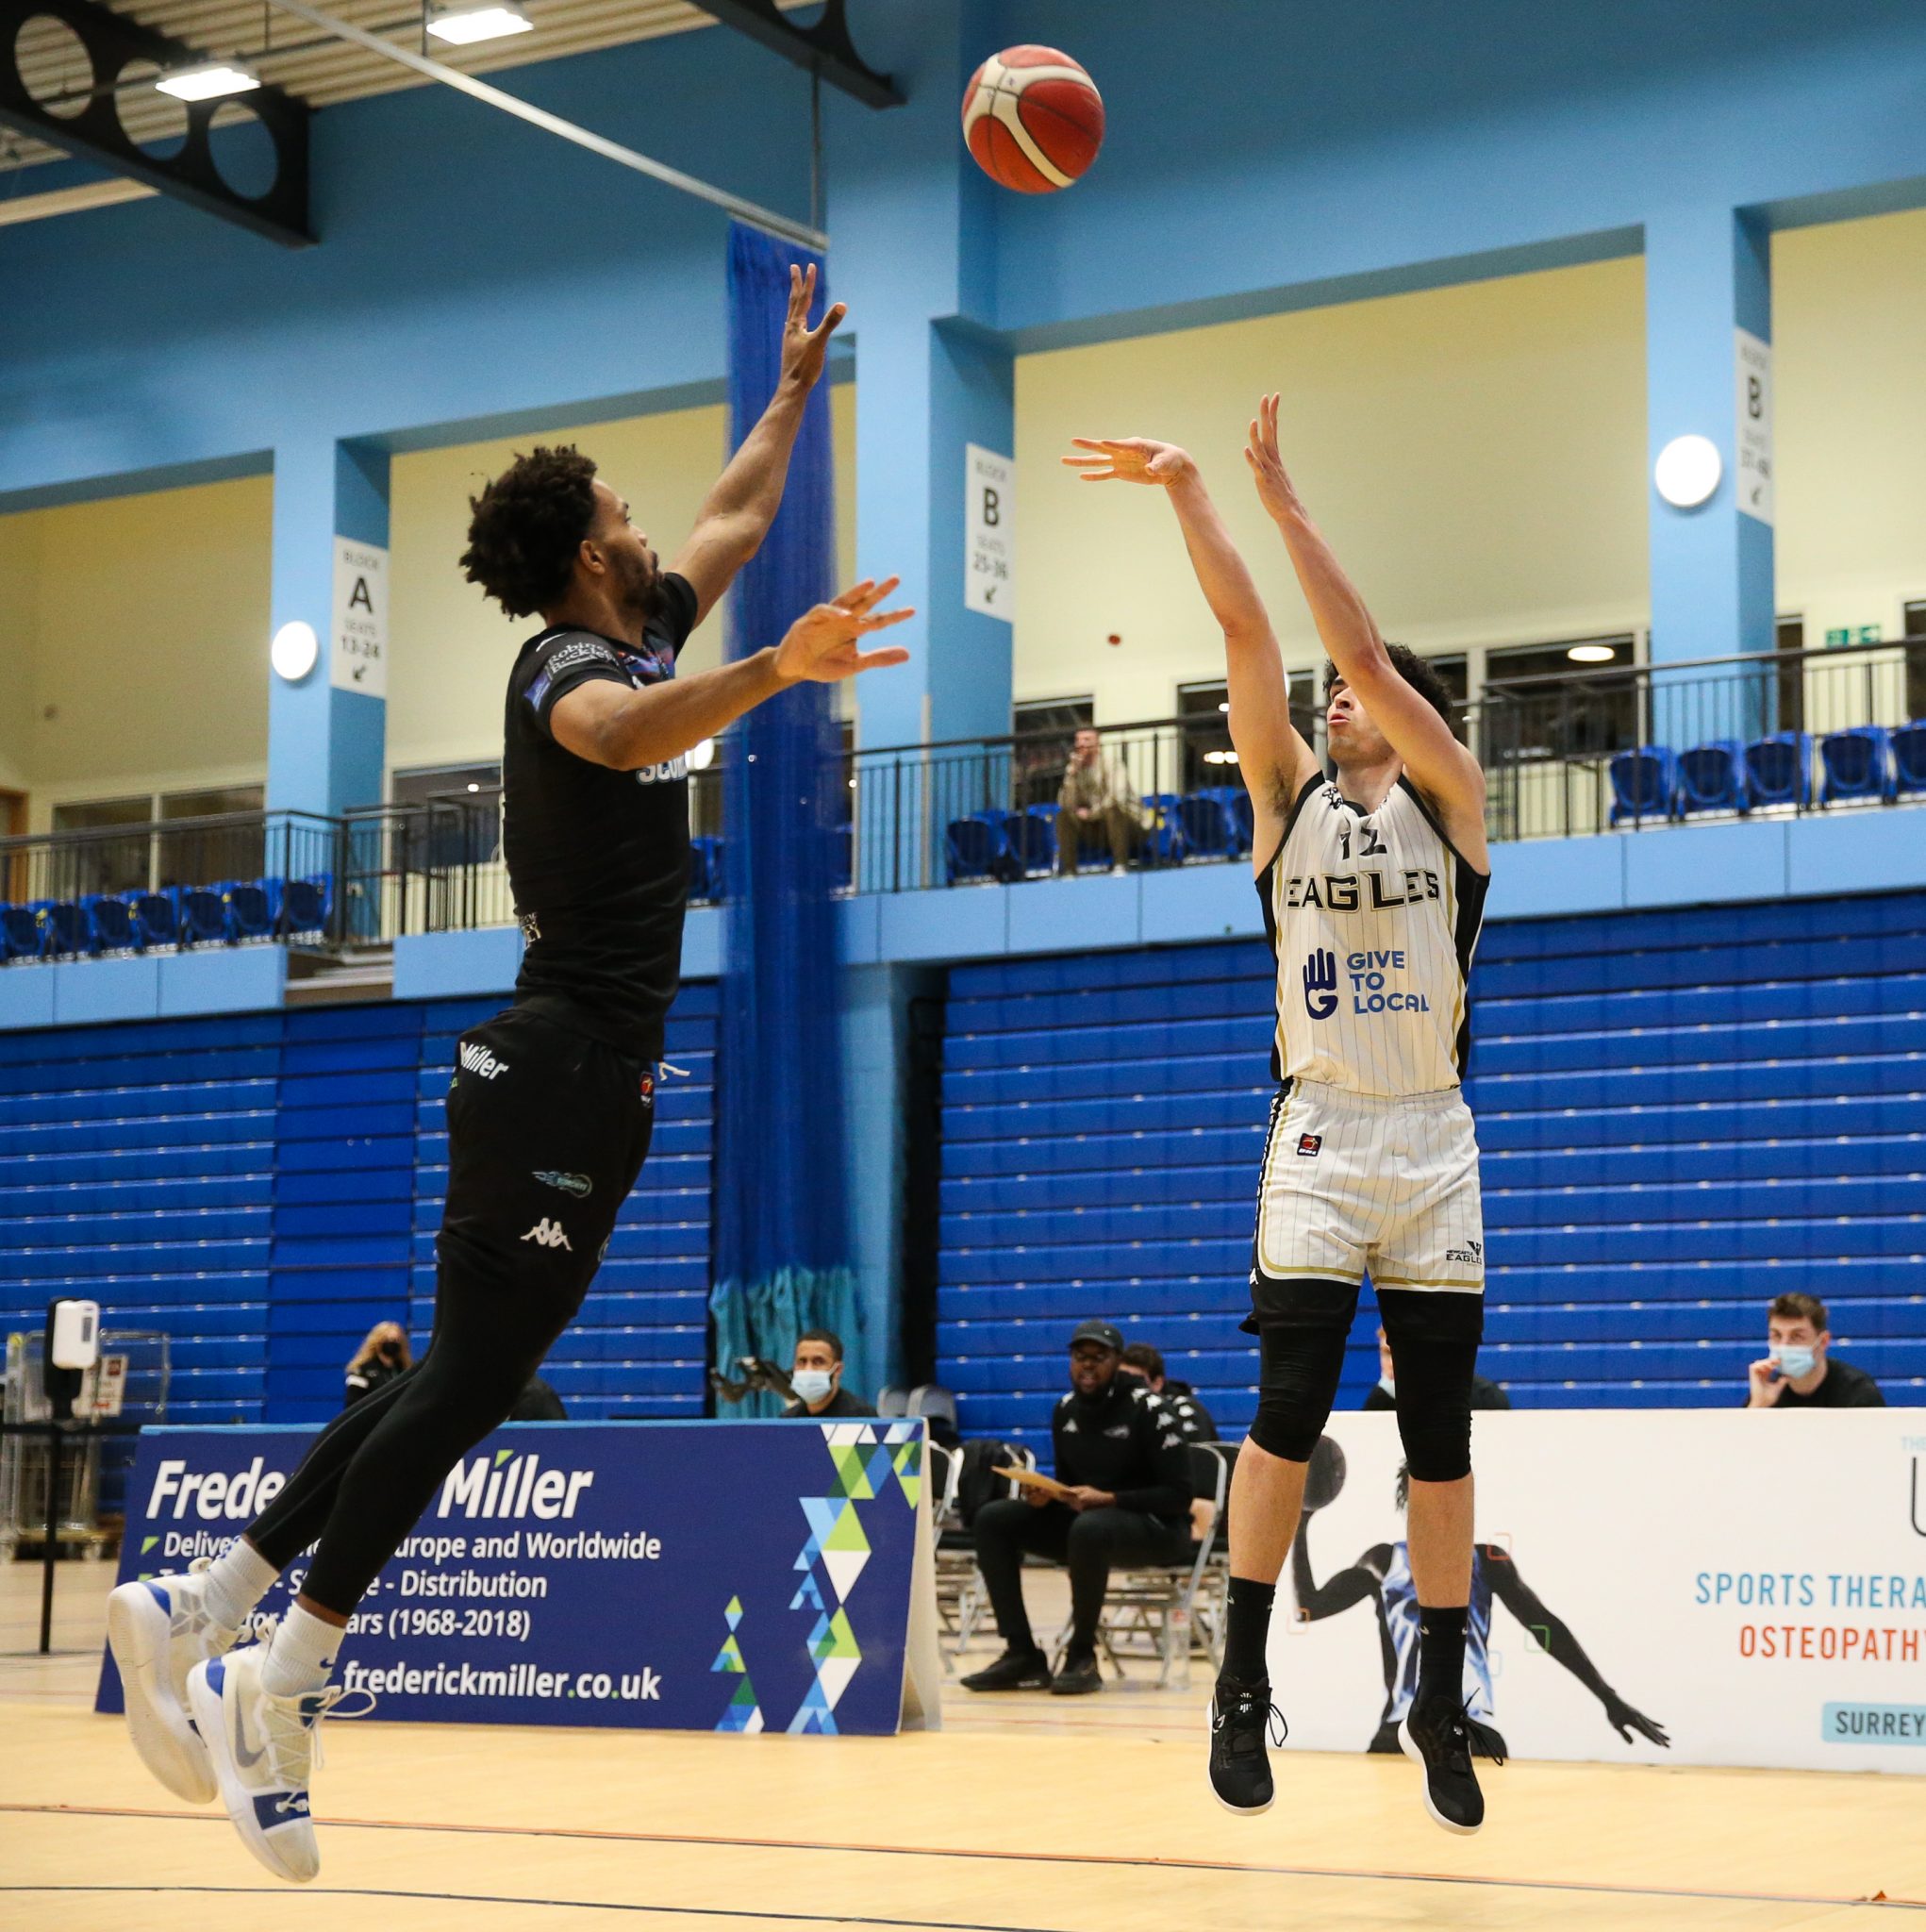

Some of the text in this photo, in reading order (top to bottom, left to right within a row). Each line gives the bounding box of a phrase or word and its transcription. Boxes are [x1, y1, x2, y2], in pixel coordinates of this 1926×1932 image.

[984, 487, 1000, 526] B
[349, 576, 374, 613] A
[1285, 868, 1441, 914] EAGLES
[1346, 950, 1405, 971] GIVE
[1350, 972, 1386, 991] TO
[1353, 993, 1430, 1015] LOCAL
[459, 1041, 510, 1080] Miller
[145, 1449, 594, 1520] Frede Miller
[163, 1530, 662, 1566] Delive urope and Worldwide
[400, 1569, 548, 1598] Distribution
[1695, 1573, 1815, 1607] SPORTS
[345, 1613, 384, 1637] ars
[388, 1607, 531, 1642] (1968-2018)
[1739, 1624, 1926, 1662] OSTEOPATH
[343, 1659, 662, 1700] frederickmiller.co.uk
[1835, 1710, 1926, 1738] SURREY
